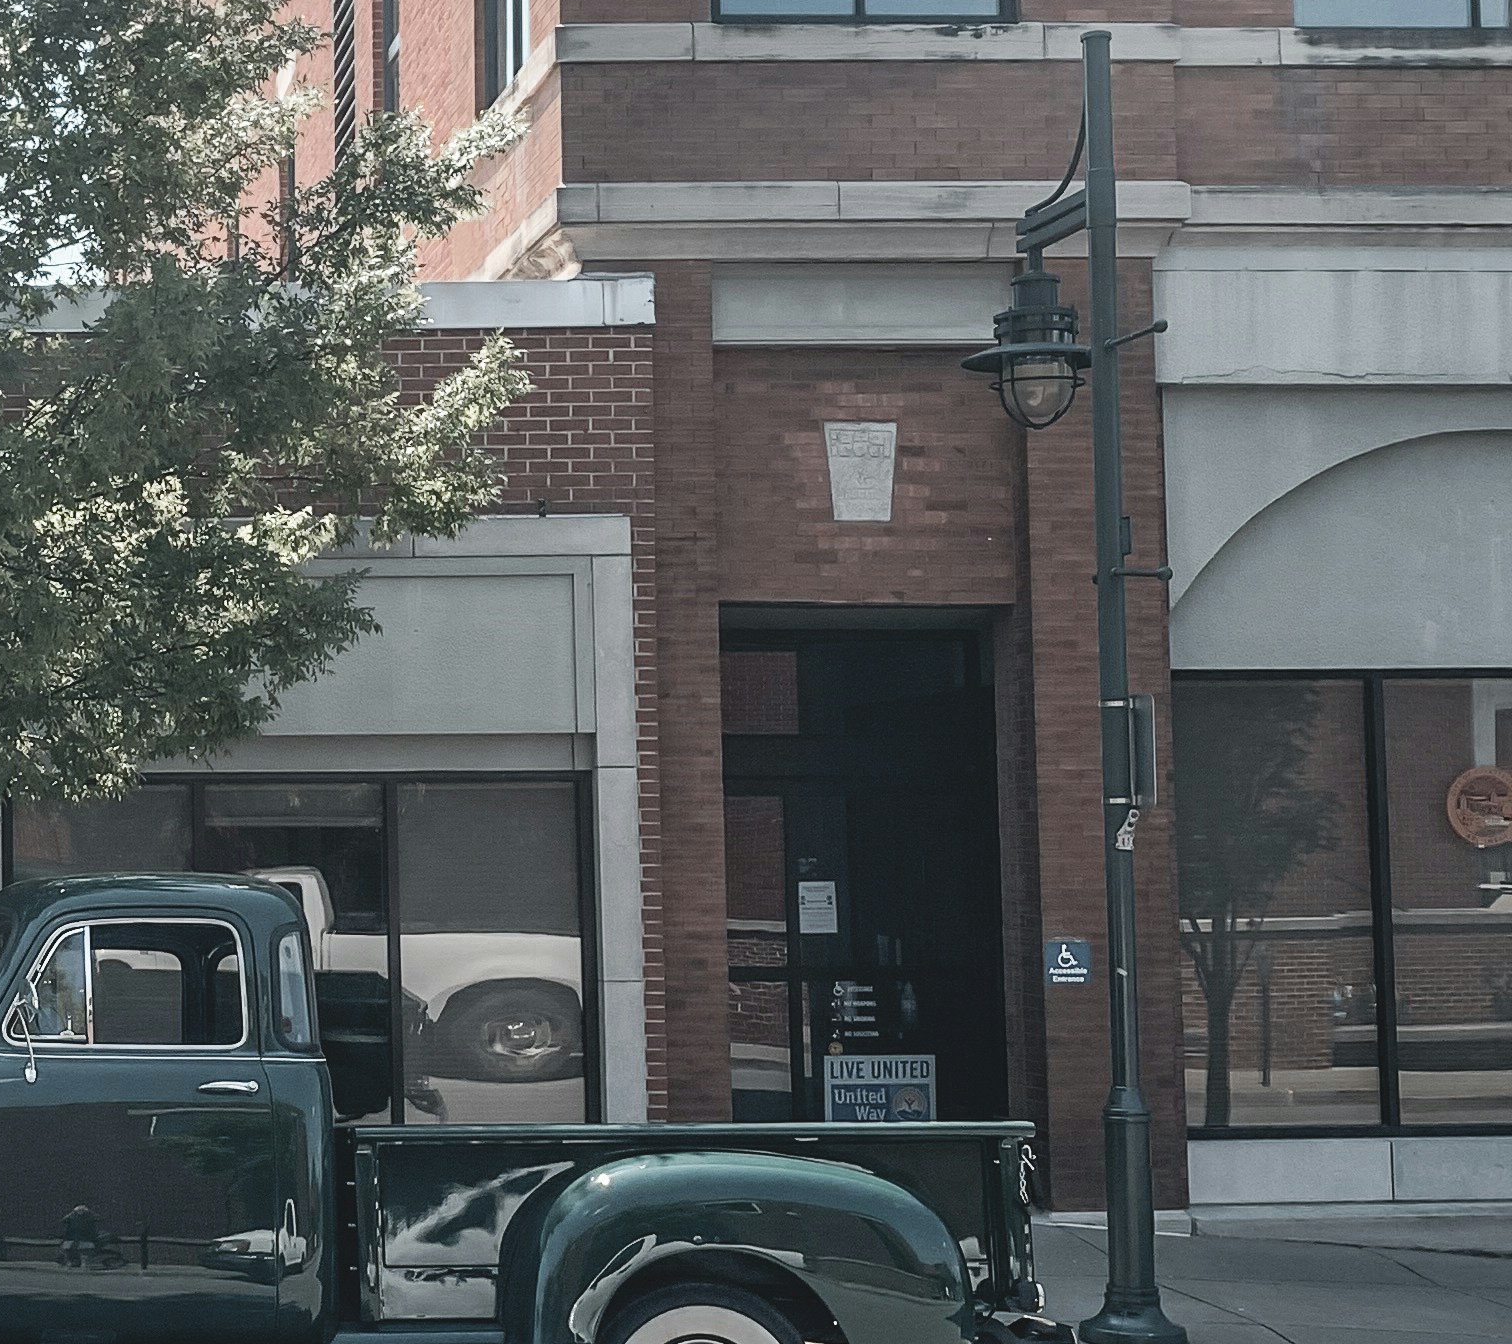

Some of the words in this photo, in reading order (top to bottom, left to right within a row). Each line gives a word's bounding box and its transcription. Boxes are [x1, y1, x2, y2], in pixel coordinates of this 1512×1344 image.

[1048, 967, 1088, 975] Accessible
[1052, 975, 1085, 983] Entrance
[830, 1060, 865, 1079] LIVE
[871, 1060, 930, 1079] UNITED
[833, 1087, 887, 1104] United
[854, 1105, 887, 1122] Way
